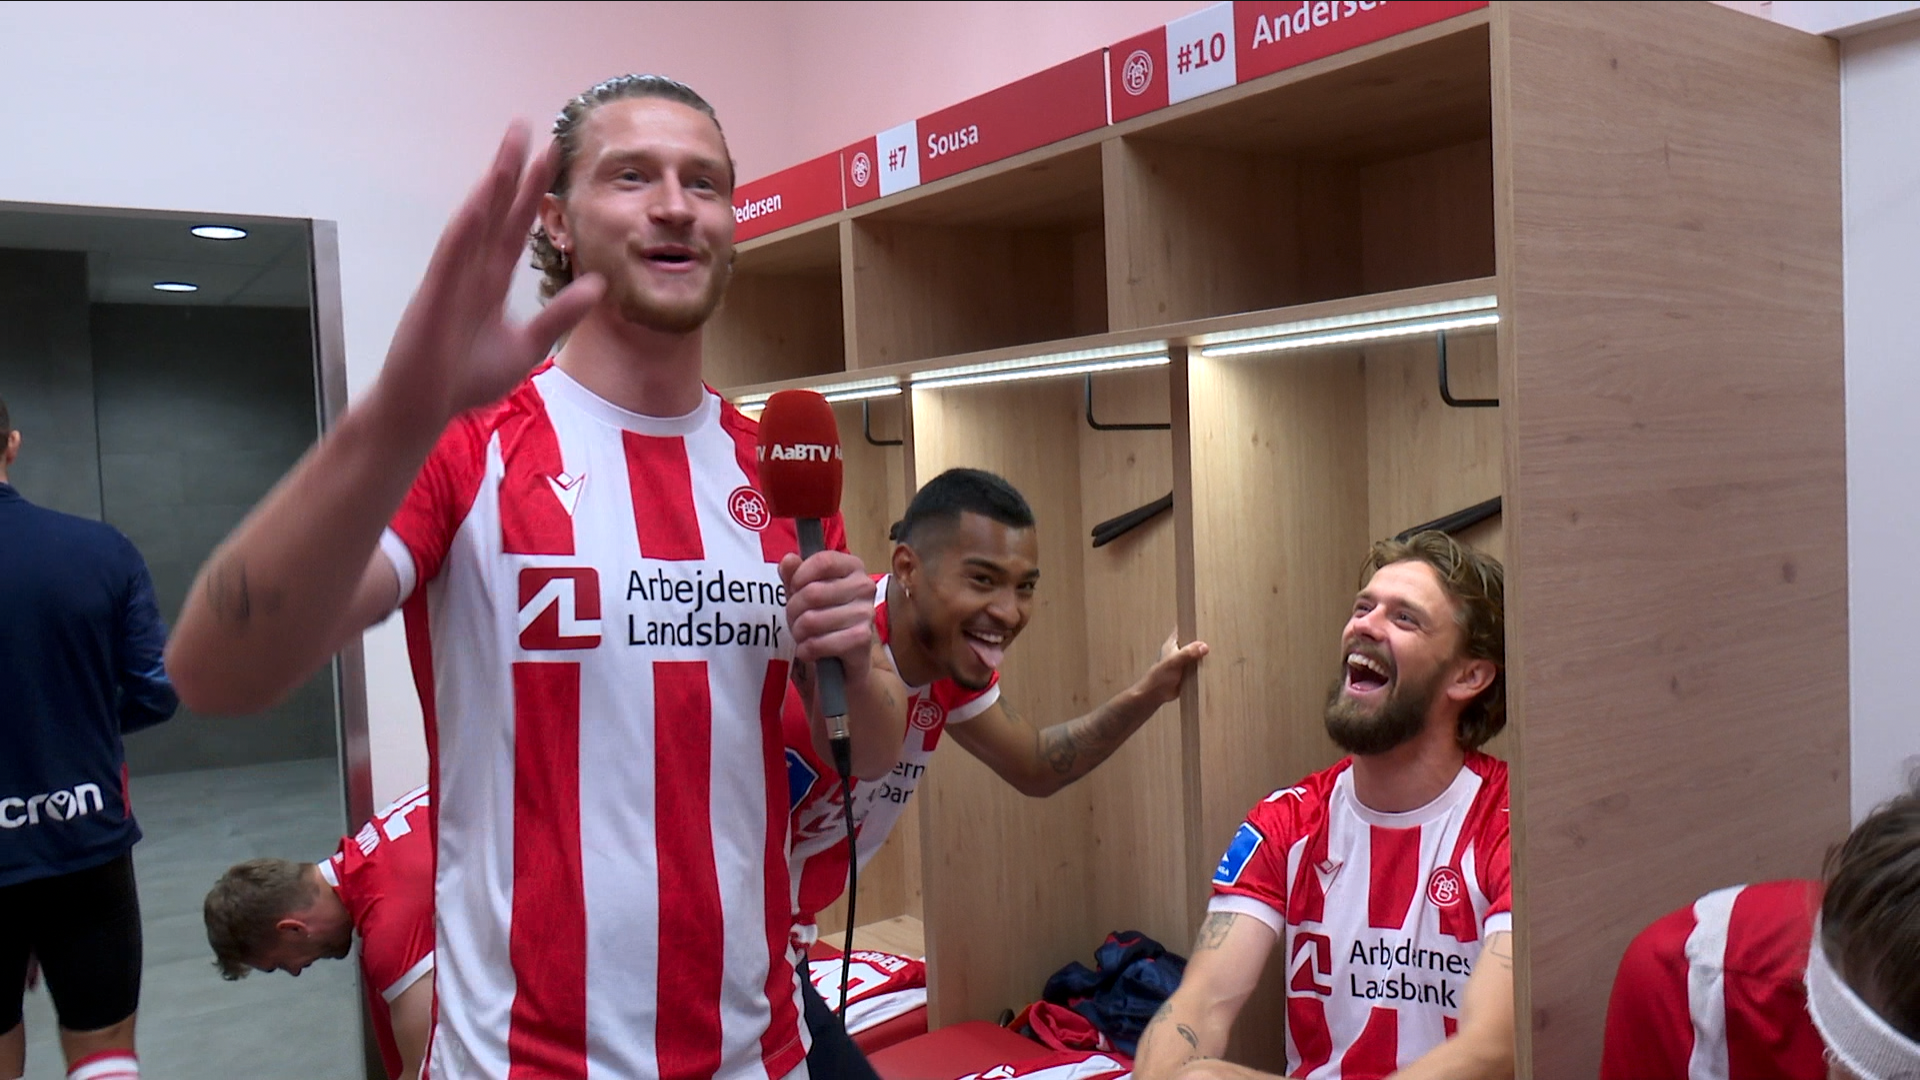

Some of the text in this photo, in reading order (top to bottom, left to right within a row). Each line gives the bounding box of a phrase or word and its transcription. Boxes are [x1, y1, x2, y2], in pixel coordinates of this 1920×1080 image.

[1177, 32, 1226, 75] #10
[888, 124, 979, 173] #7 Sousa
[770, 443, 832, 463] AaBTV
[626, 568, 787, 612] Arbejderne
[628, 612, 782, 649] Landsbank
